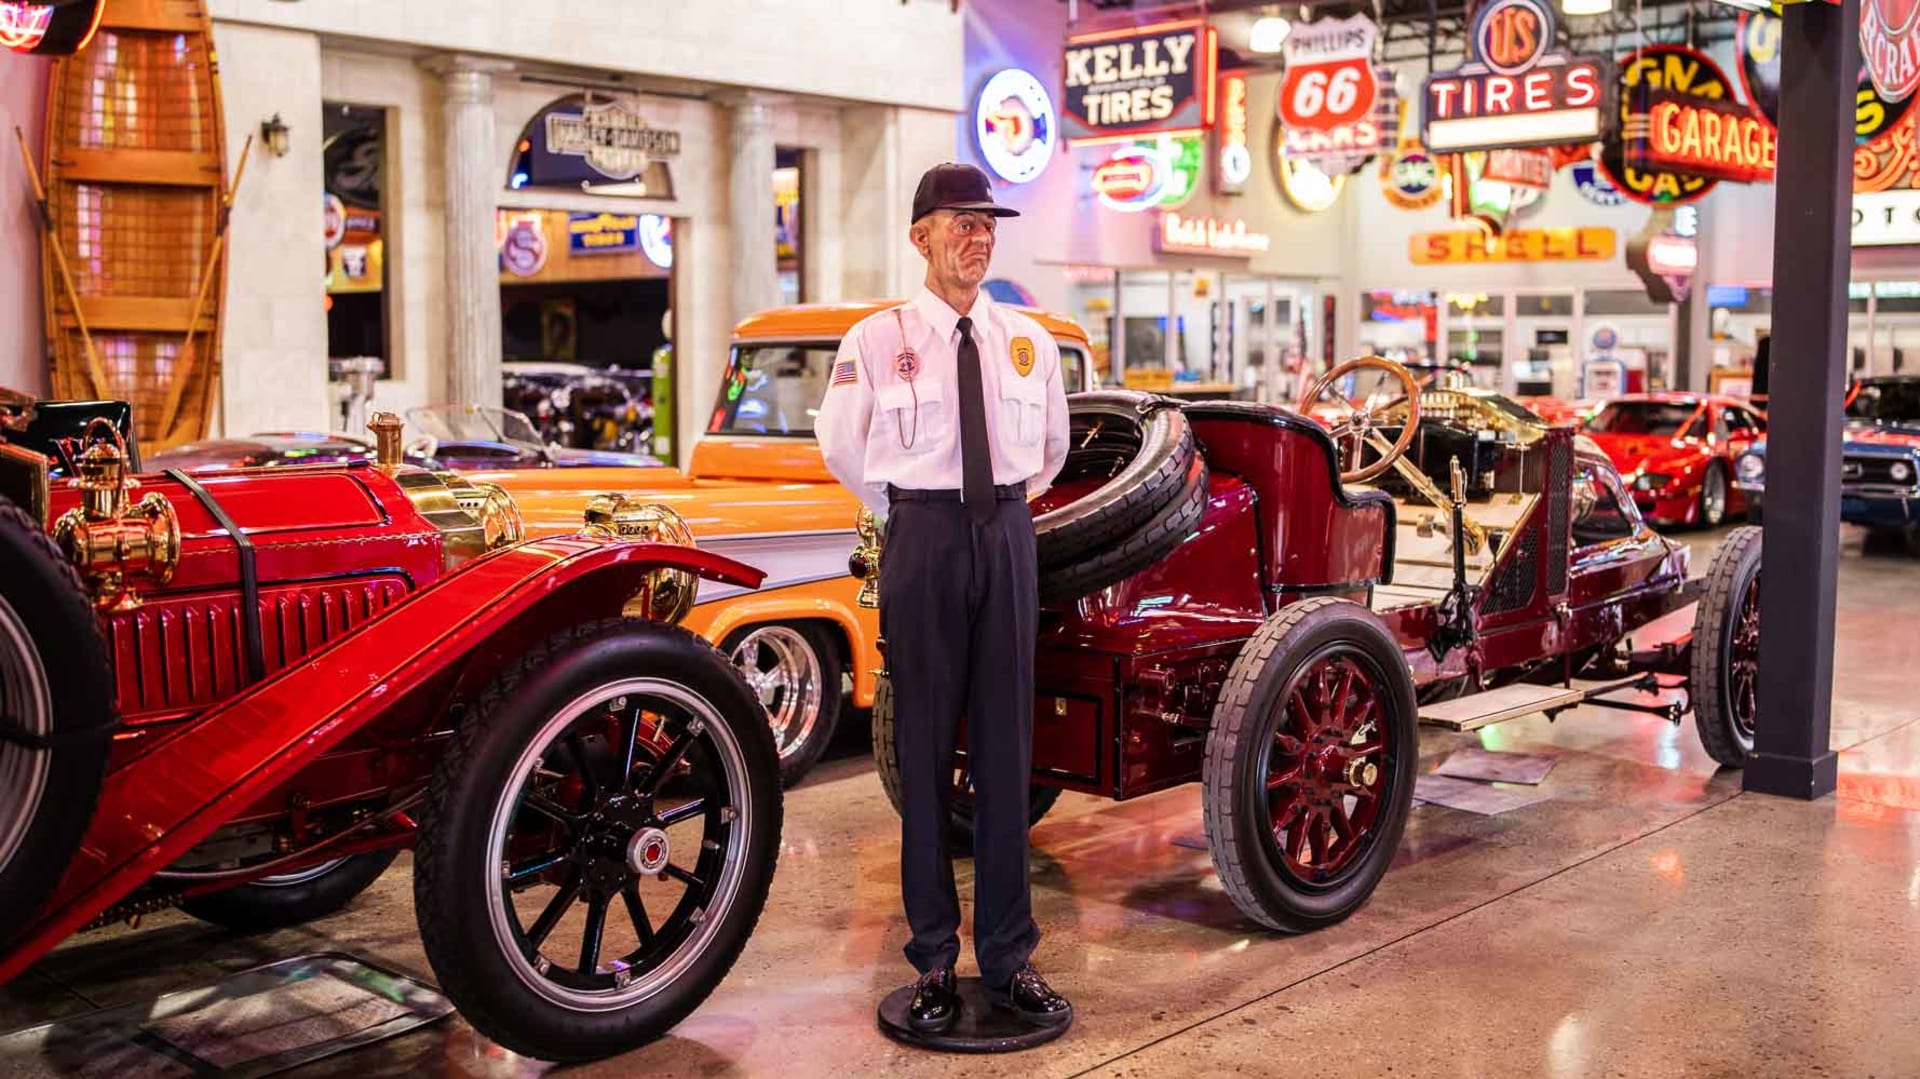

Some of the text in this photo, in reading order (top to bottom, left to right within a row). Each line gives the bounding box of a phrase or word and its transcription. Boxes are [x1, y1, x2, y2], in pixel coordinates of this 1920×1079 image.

[1065, 34, 1195, 87] KELLY
[1293, 28, 1365, 53] PHILLIPS
[1489, 7, 1537, 66] US
[1082, 85, 1174, 126] TIRES
[1293, 67, 1362, 118] 66
[1430, 67, 1600, 119] TIRES
[1426, 229, 1600, 260] SHELL
